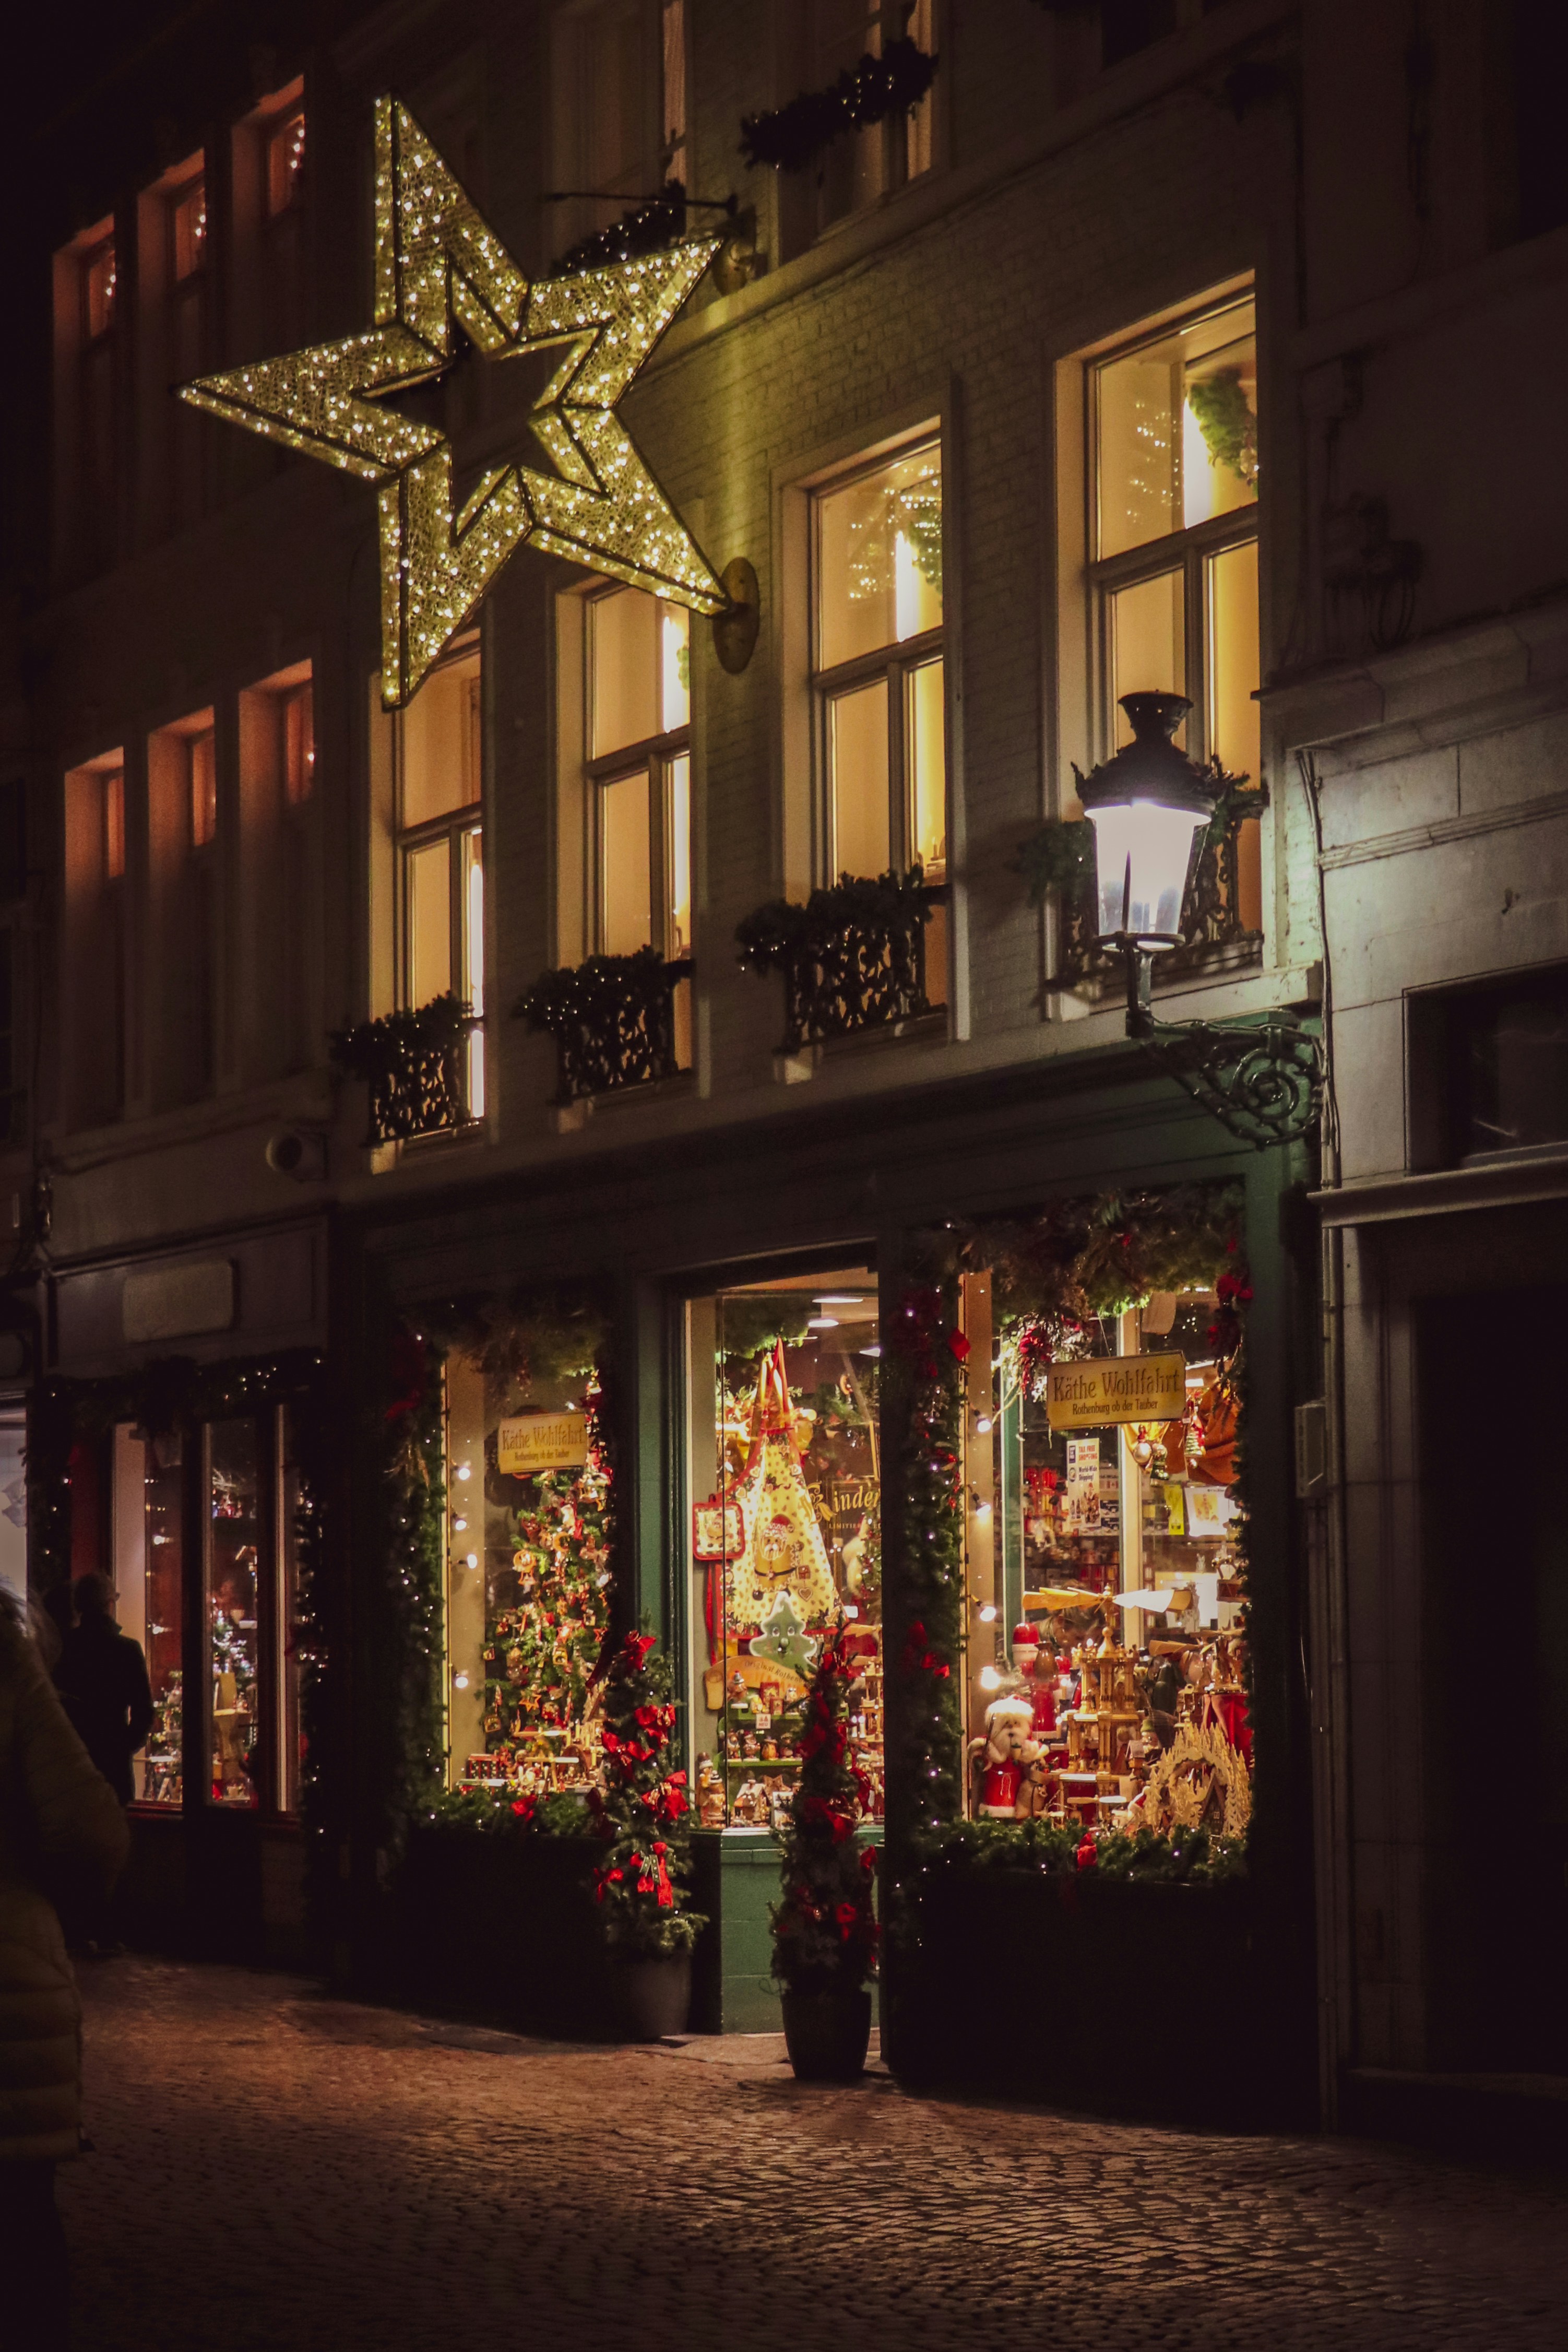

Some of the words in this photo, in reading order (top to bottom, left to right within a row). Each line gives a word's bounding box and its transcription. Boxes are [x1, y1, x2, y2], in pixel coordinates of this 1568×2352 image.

[1053, 1374, 1097, 1402] Käthe
[1101, 1368, 1180, 1398] Wohlfahrt
[1073, 1402, 1110, 1415] Rothenburg
[1112, 1400, 1120, 1412] ob
[1123, 1400, 1133, 1411] der
[1135, 1398, 1158, 1410] Tauber
